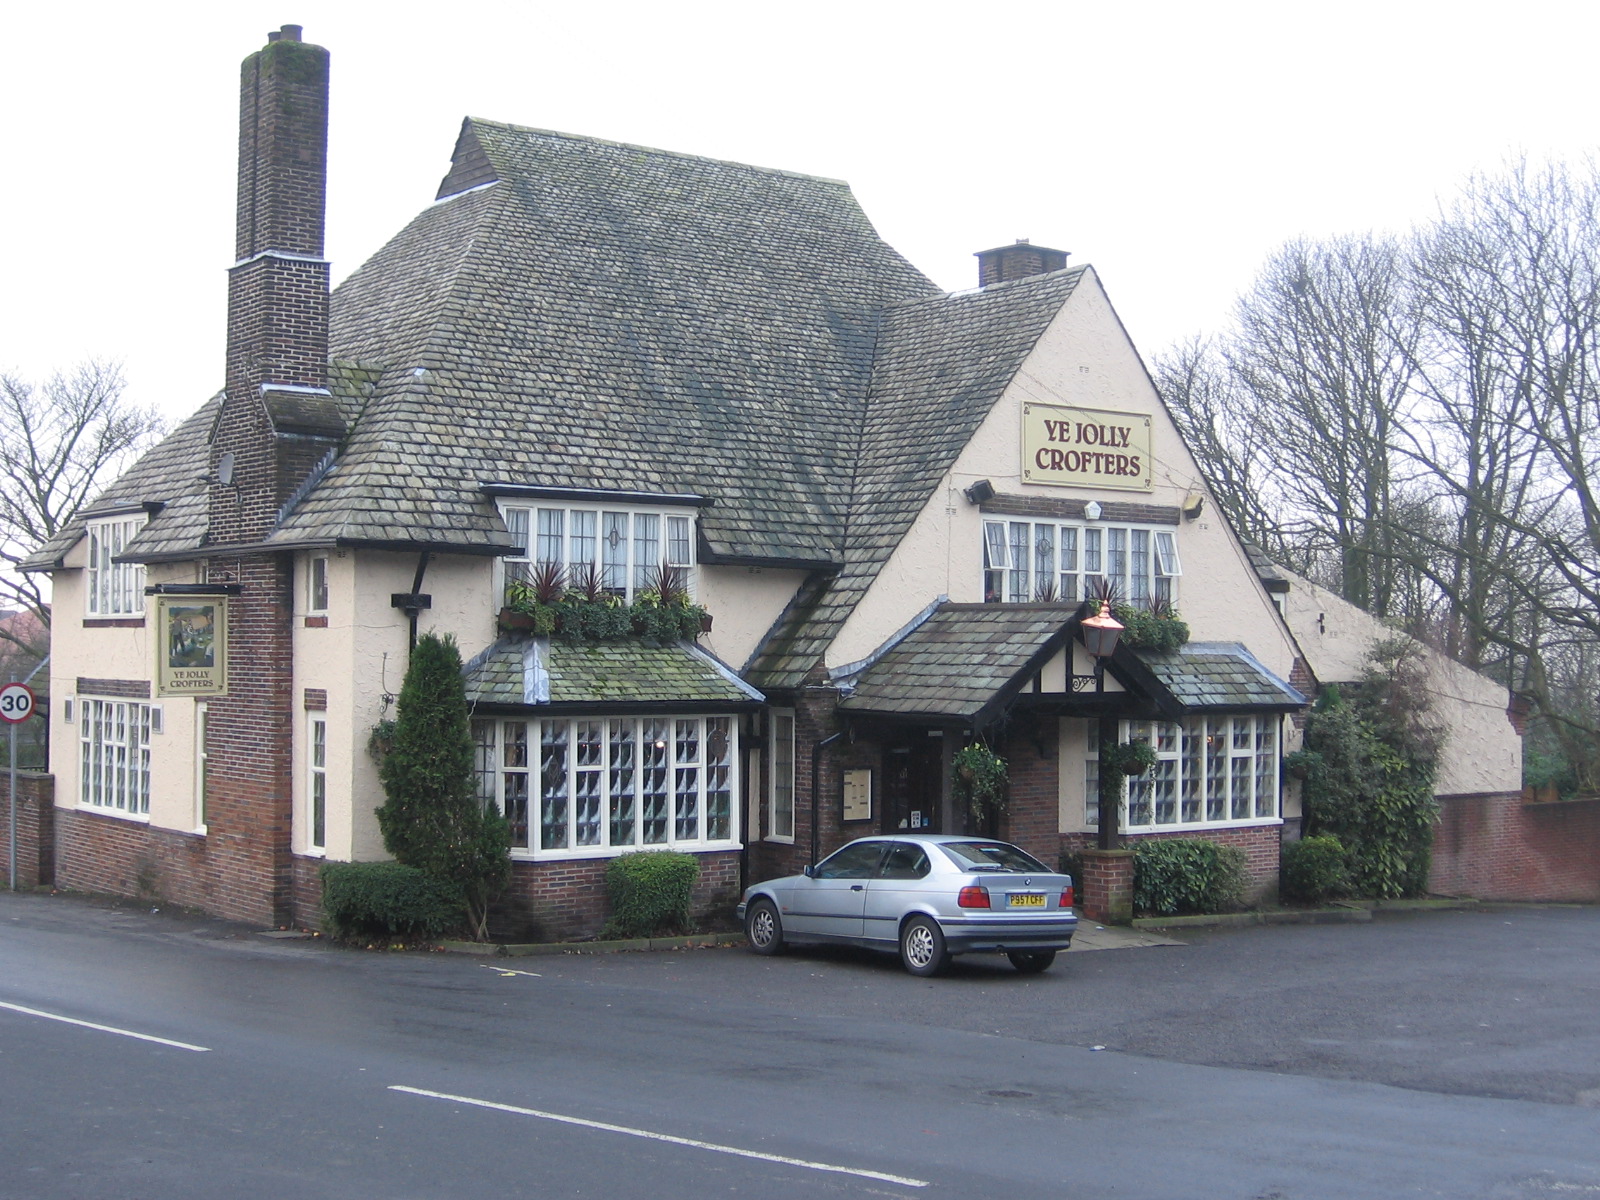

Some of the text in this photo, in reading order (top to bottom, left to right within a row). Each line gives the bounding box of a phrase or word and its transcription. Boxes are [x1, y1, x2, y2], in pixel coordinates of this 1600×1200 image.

[1044, 420, 1131, 448] YE JOLLY
[1035, 448, 1141, 477] CROFTERS
[174, 671, 209, 679] YE JOLLY
[170, 680, 213, 688] CROFTERS
[2, 695, 29, 711] 30
